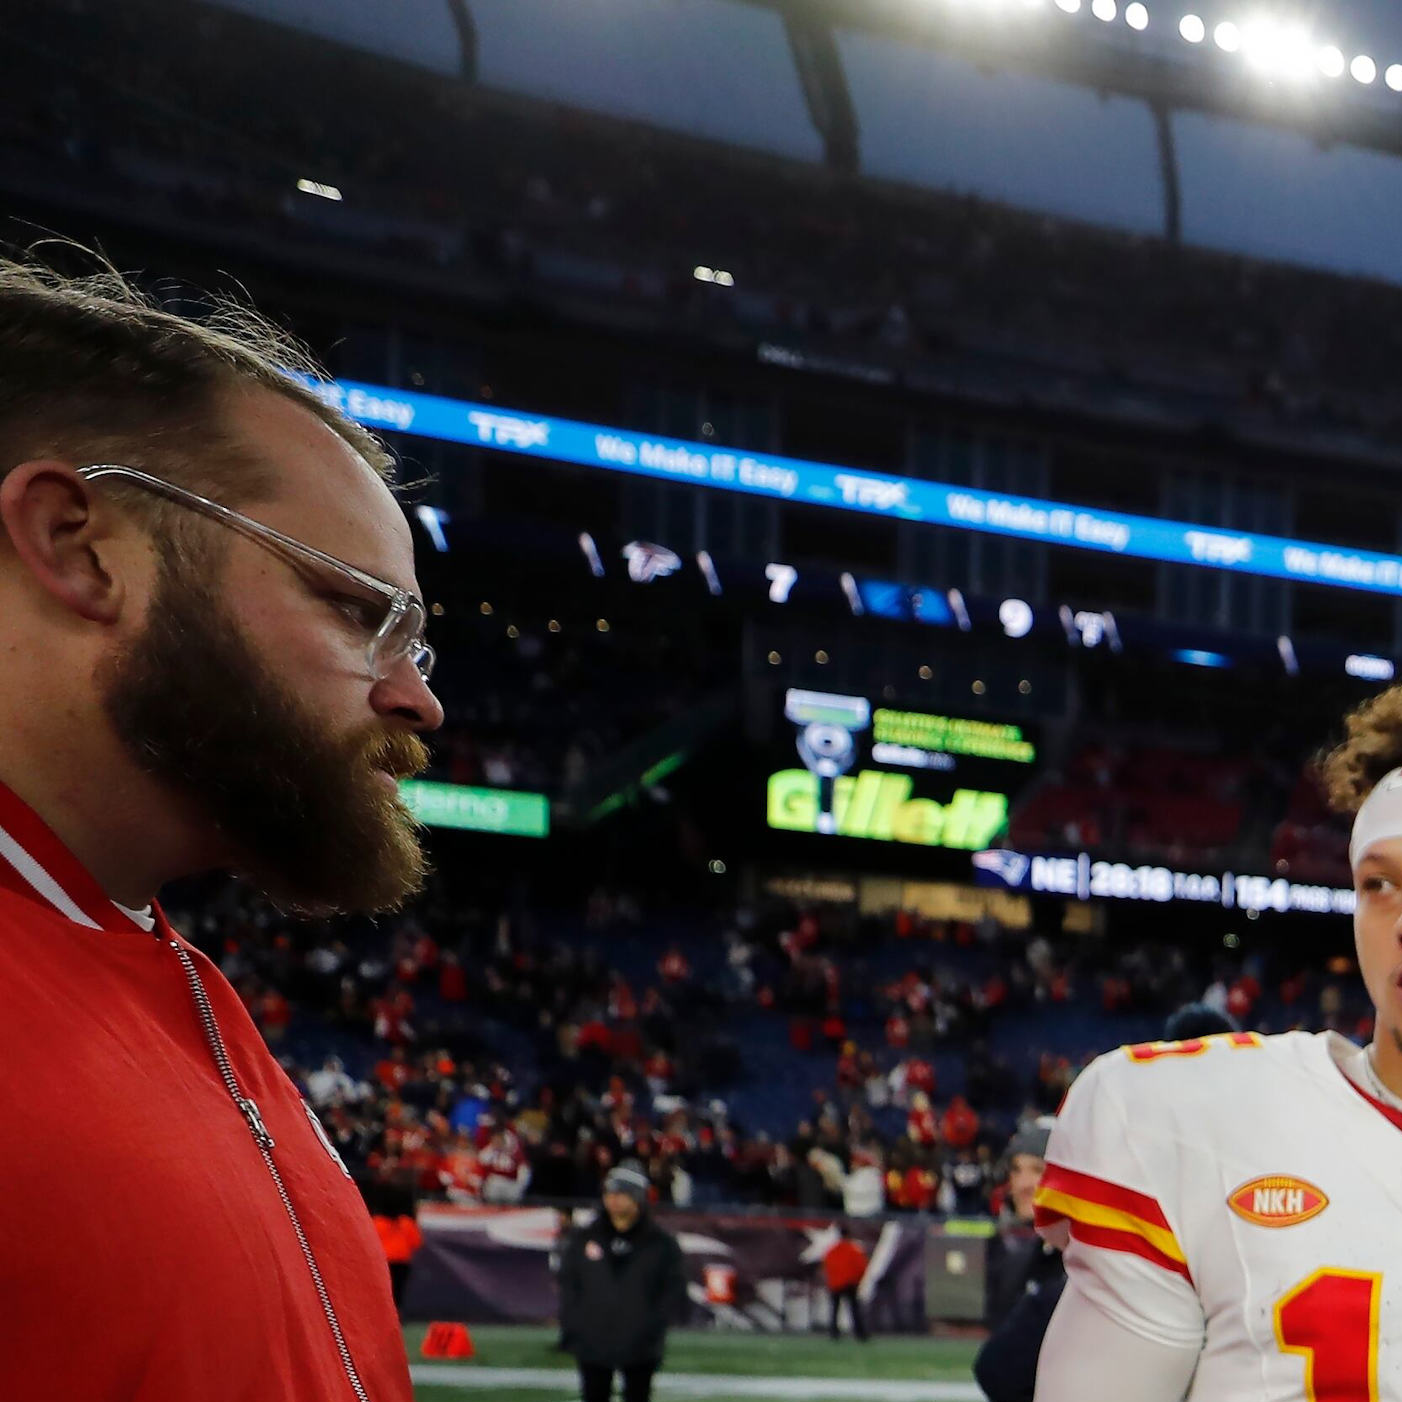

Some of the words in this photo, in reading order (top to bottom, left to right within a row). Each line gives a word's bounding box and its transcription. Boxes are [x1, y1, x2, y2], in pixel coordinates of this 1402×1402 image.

[596, 435, 635, 463] We
[639, 441, 708, 475] Make
[739, 458, 797, 495] Easy
[1031, 856, 1077, 895] NE
[1253, 1187, 1304, 1214] NKH
